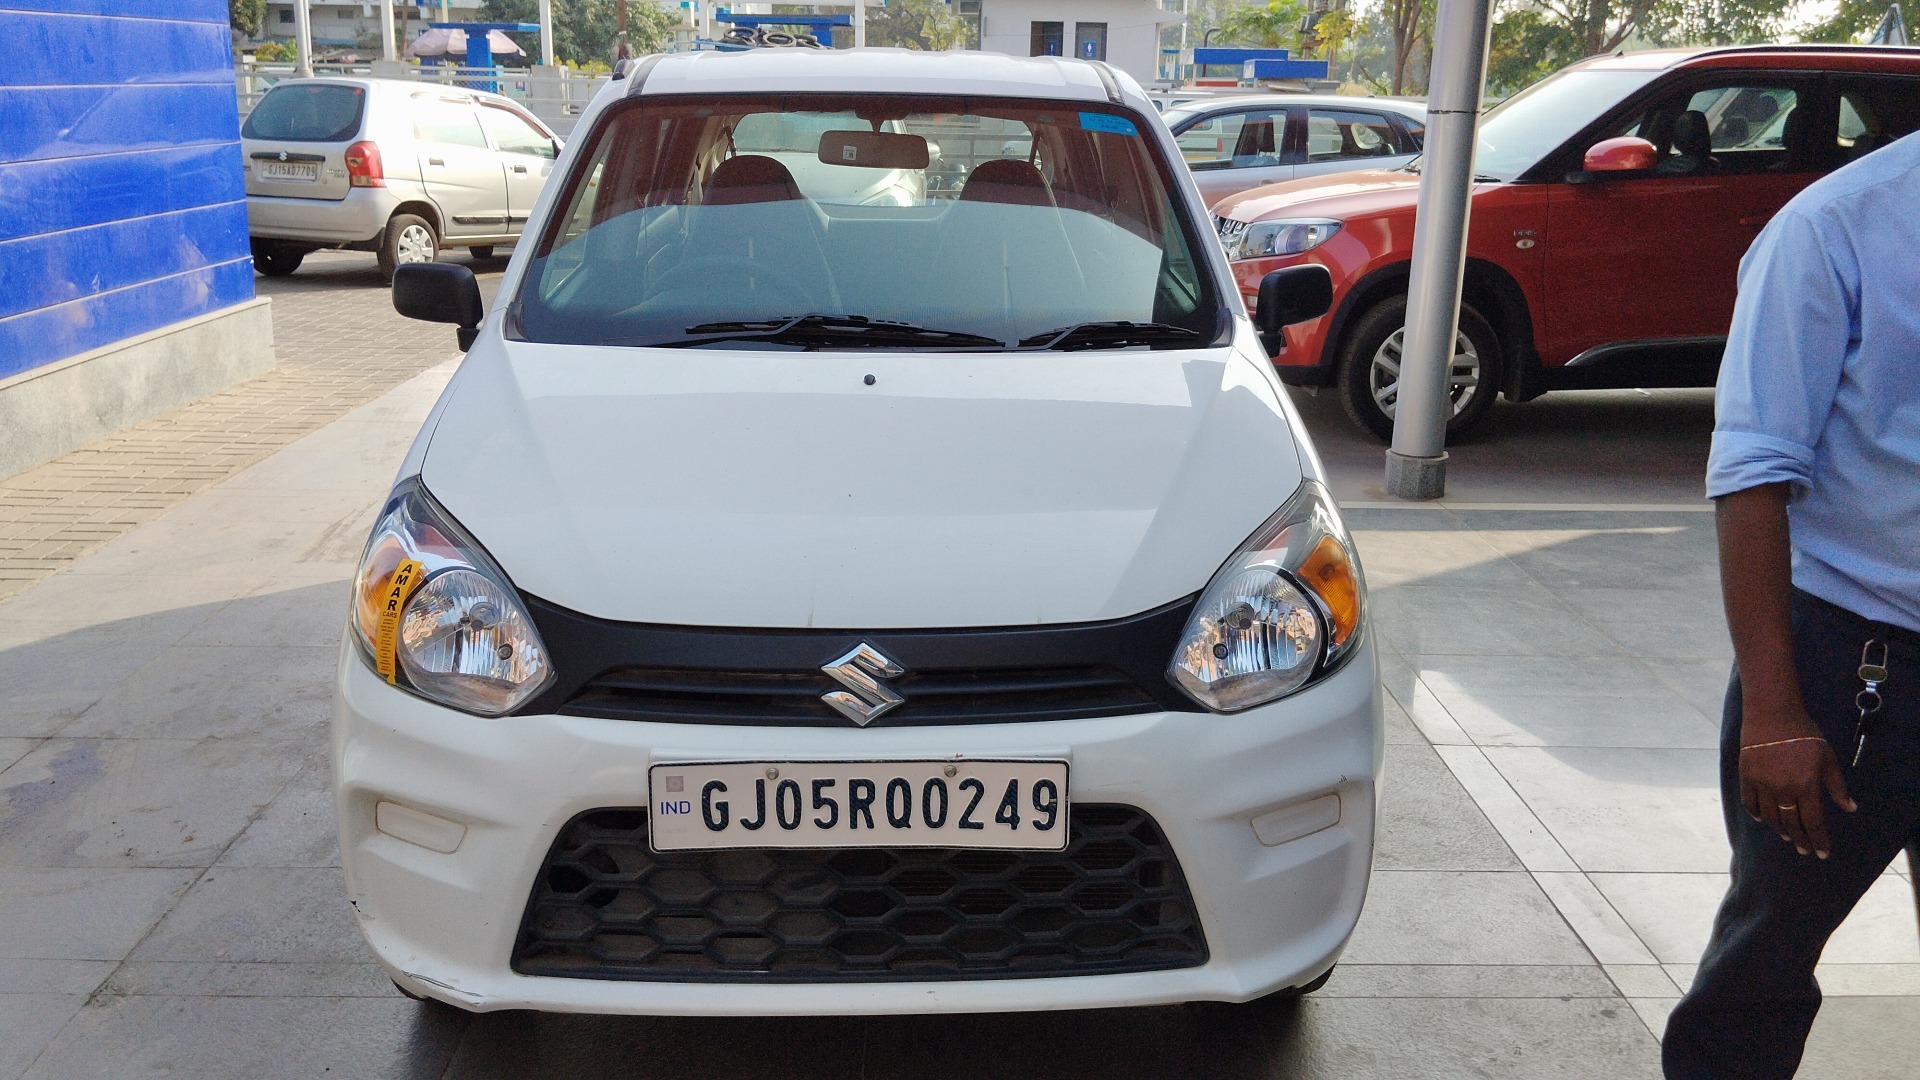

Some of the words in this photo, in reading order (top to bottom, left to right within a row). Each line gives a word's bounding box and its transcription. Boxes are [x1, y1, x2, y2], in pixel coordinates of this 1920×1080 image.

[387, 564, 413, 611] AMAR
[382, 611, 398, 619] CARS
[660, 801, 691, 815] IND
[701, 777, 1058, 831] GJ05RQ0249
